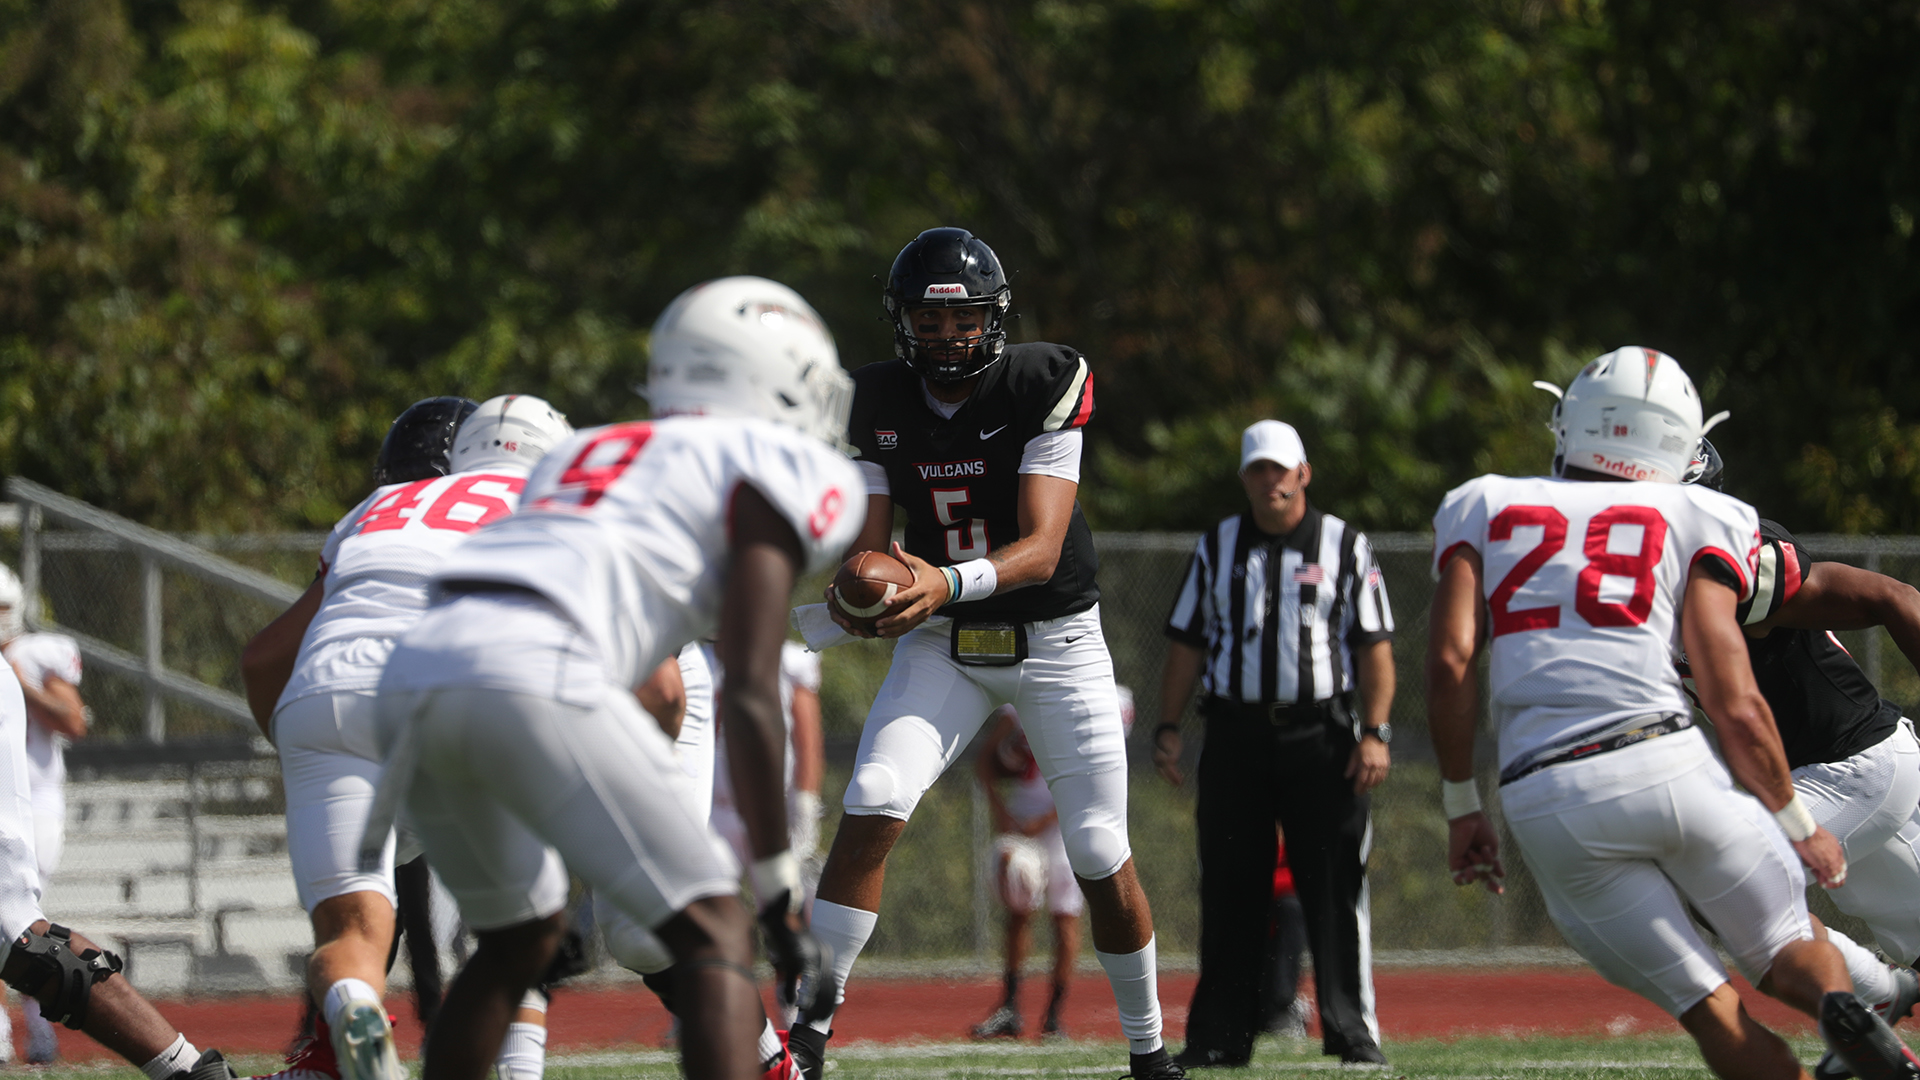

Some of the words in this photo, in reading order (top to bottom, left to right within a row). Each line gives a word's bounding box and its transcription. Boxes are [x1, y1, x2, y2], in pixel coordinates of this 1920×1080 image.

[929, 286, 962, 294] Riddell
[916, 460, 986, 480] VULCANS
[355, 473, 528, 536] 46
[930, 486, 991, 563] 5
[1488, 505, 1668, 638] 28
